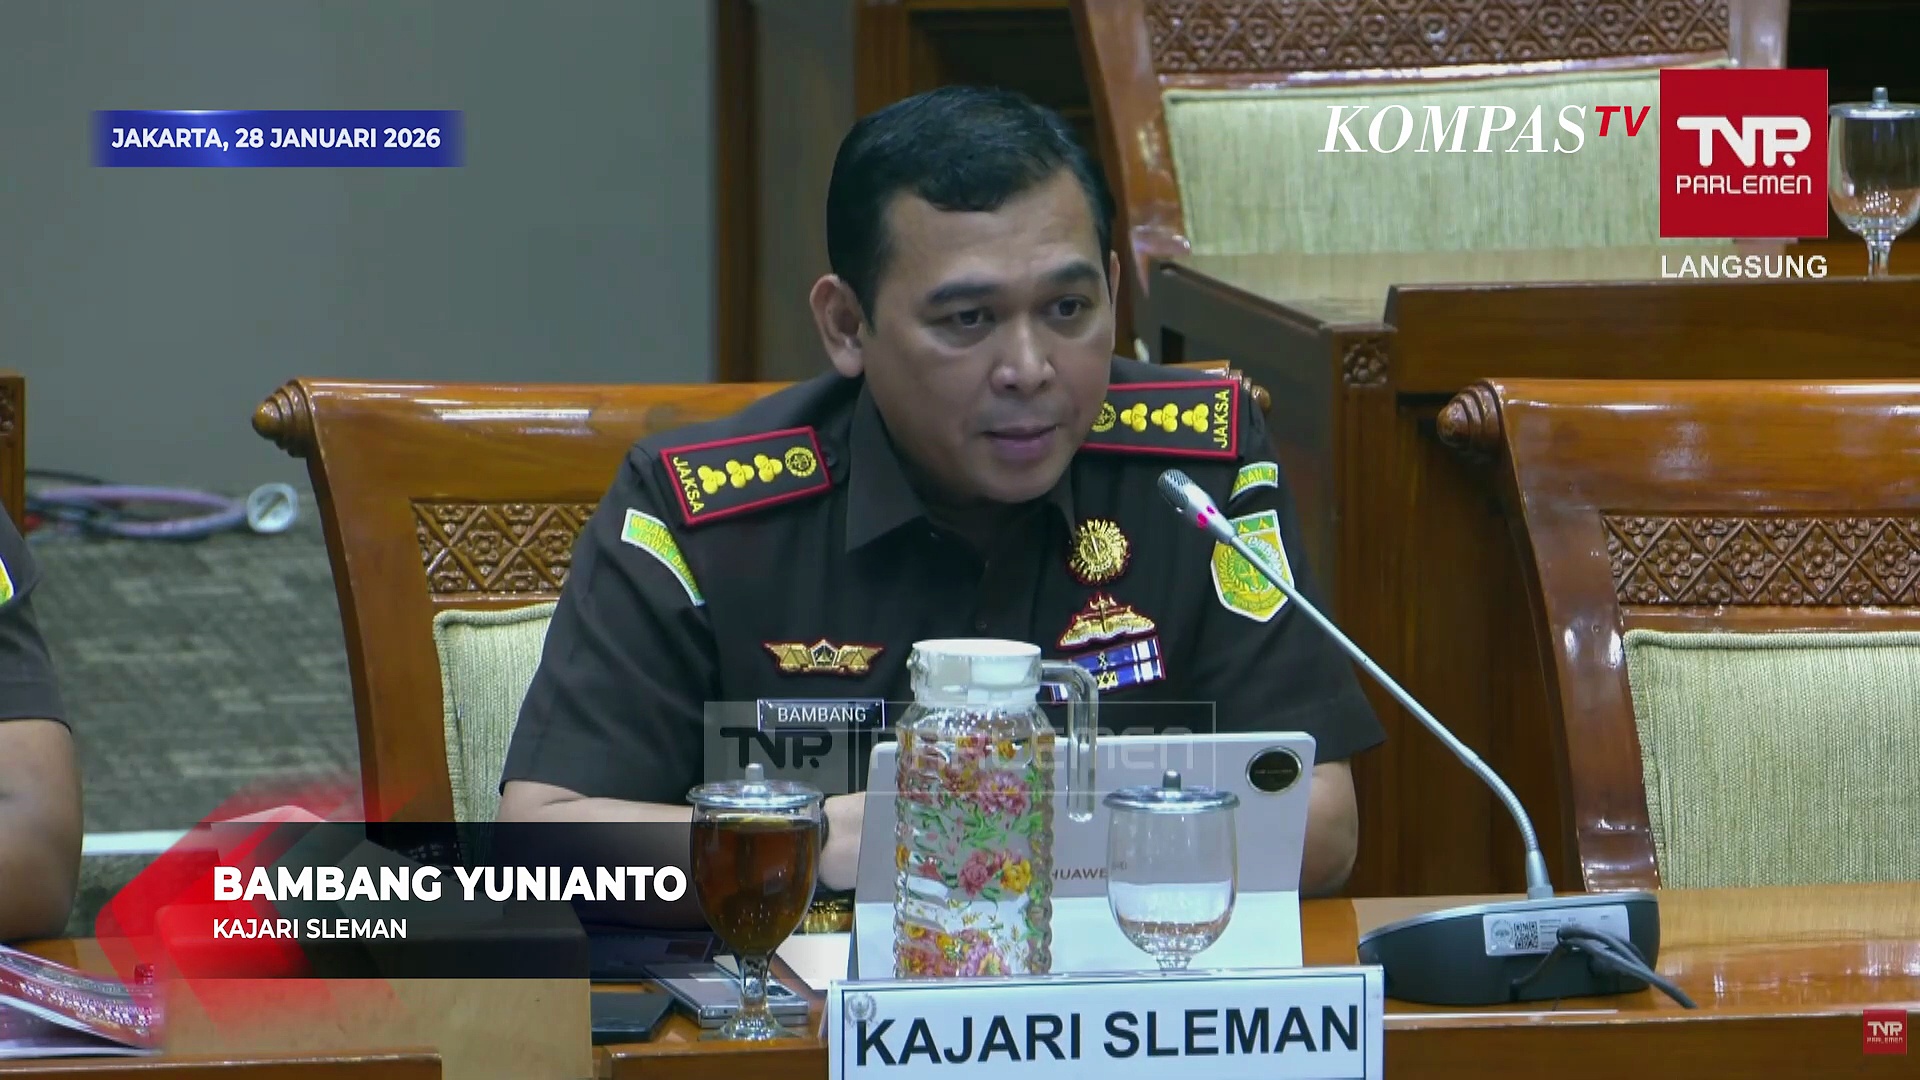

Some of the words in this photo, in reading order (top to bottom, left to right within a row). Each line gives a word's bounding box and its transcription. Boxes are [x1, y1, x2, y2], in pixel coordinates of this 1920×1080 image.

[1213, 389, 1230, 448] JAKSA
[673, 456, 704, 514] JAKSA
[777, 706, 867, 723] BAMBANG
[1052, 867, 1108, 880] HUAWE
[856, 1013, 1081, 1066] KAJARI
[1103, 1004, 1359, 1058] SLEMAN
